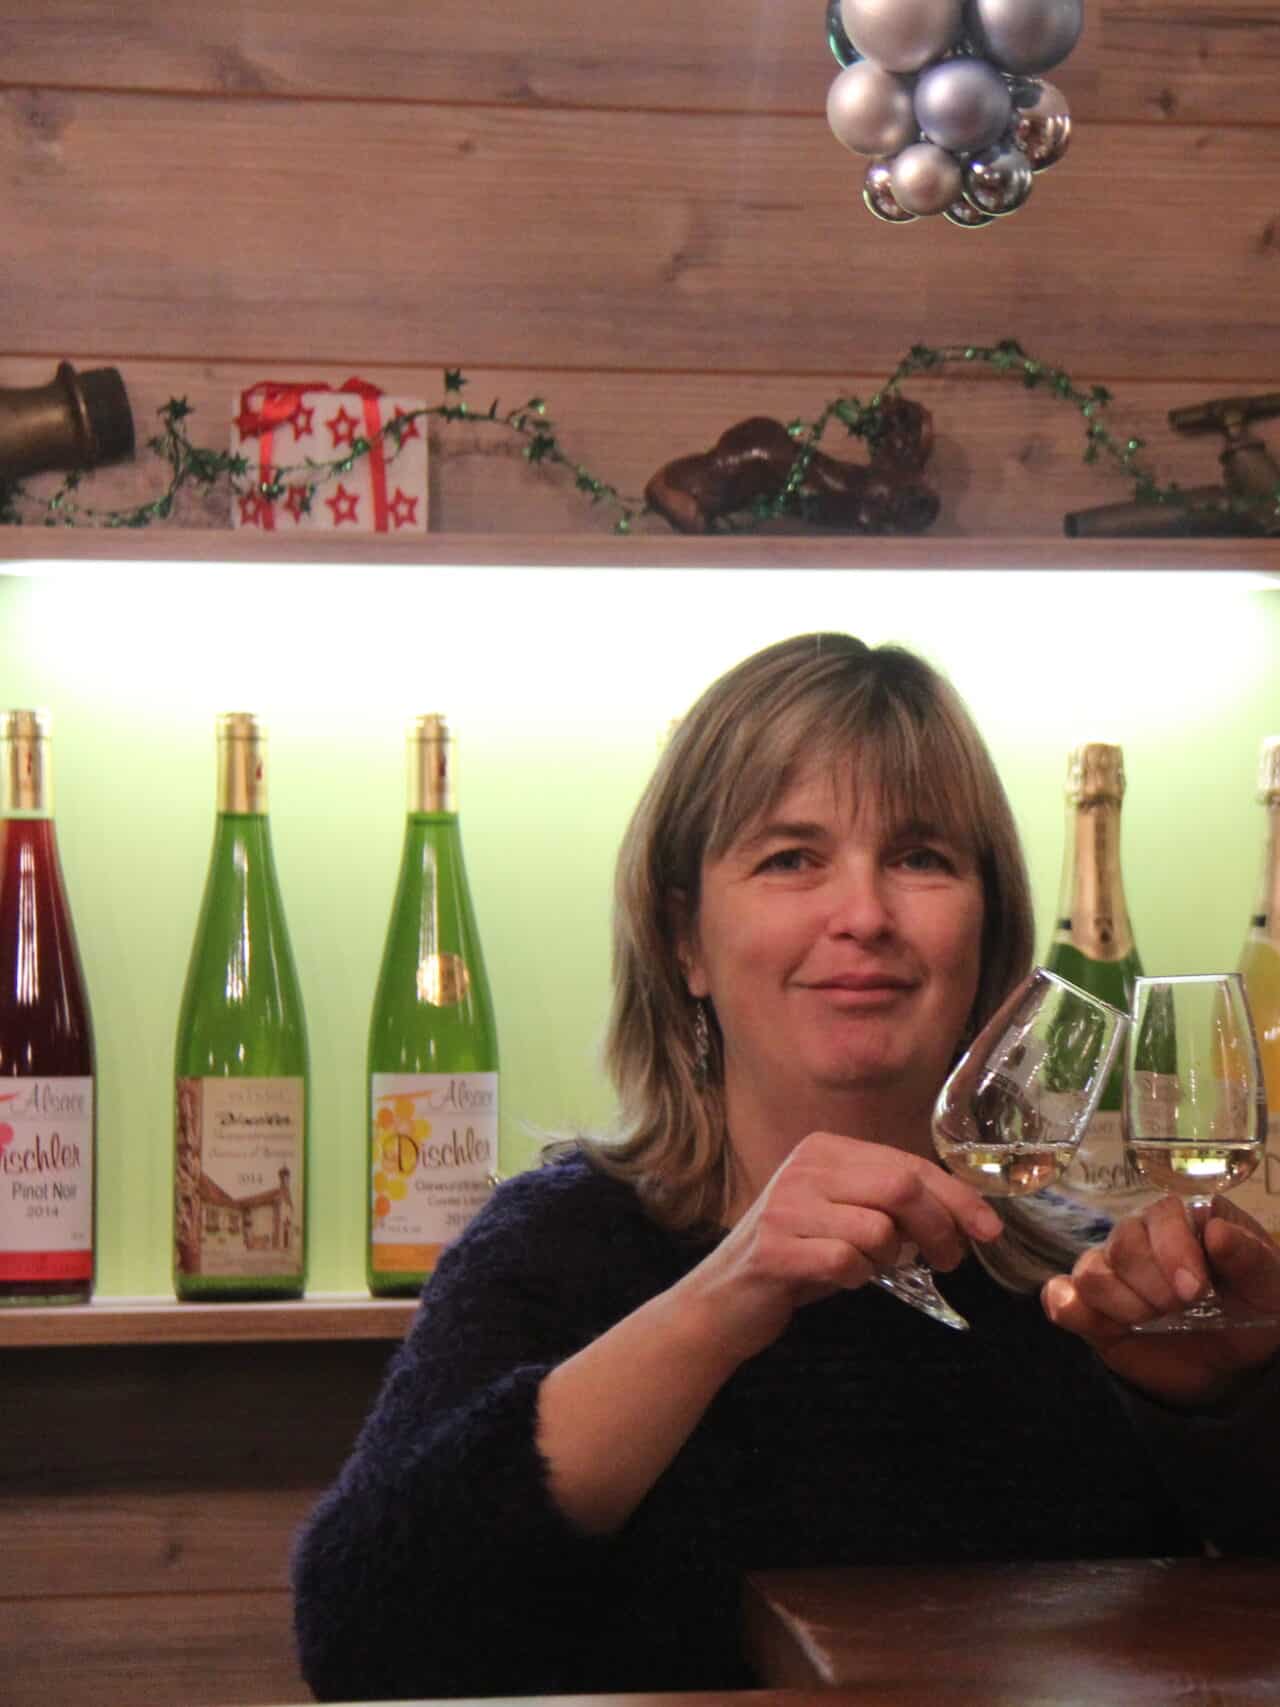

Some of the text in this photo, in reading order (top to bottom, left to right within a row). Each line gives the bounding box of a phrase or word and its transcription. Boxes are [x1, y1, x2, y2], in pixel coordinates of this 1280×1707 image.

[1, 1132, 80, 1175] ischler
[12, 1182, 77, 1200] Pinot Noir
[26, 1206, 58, 1217] 2014
